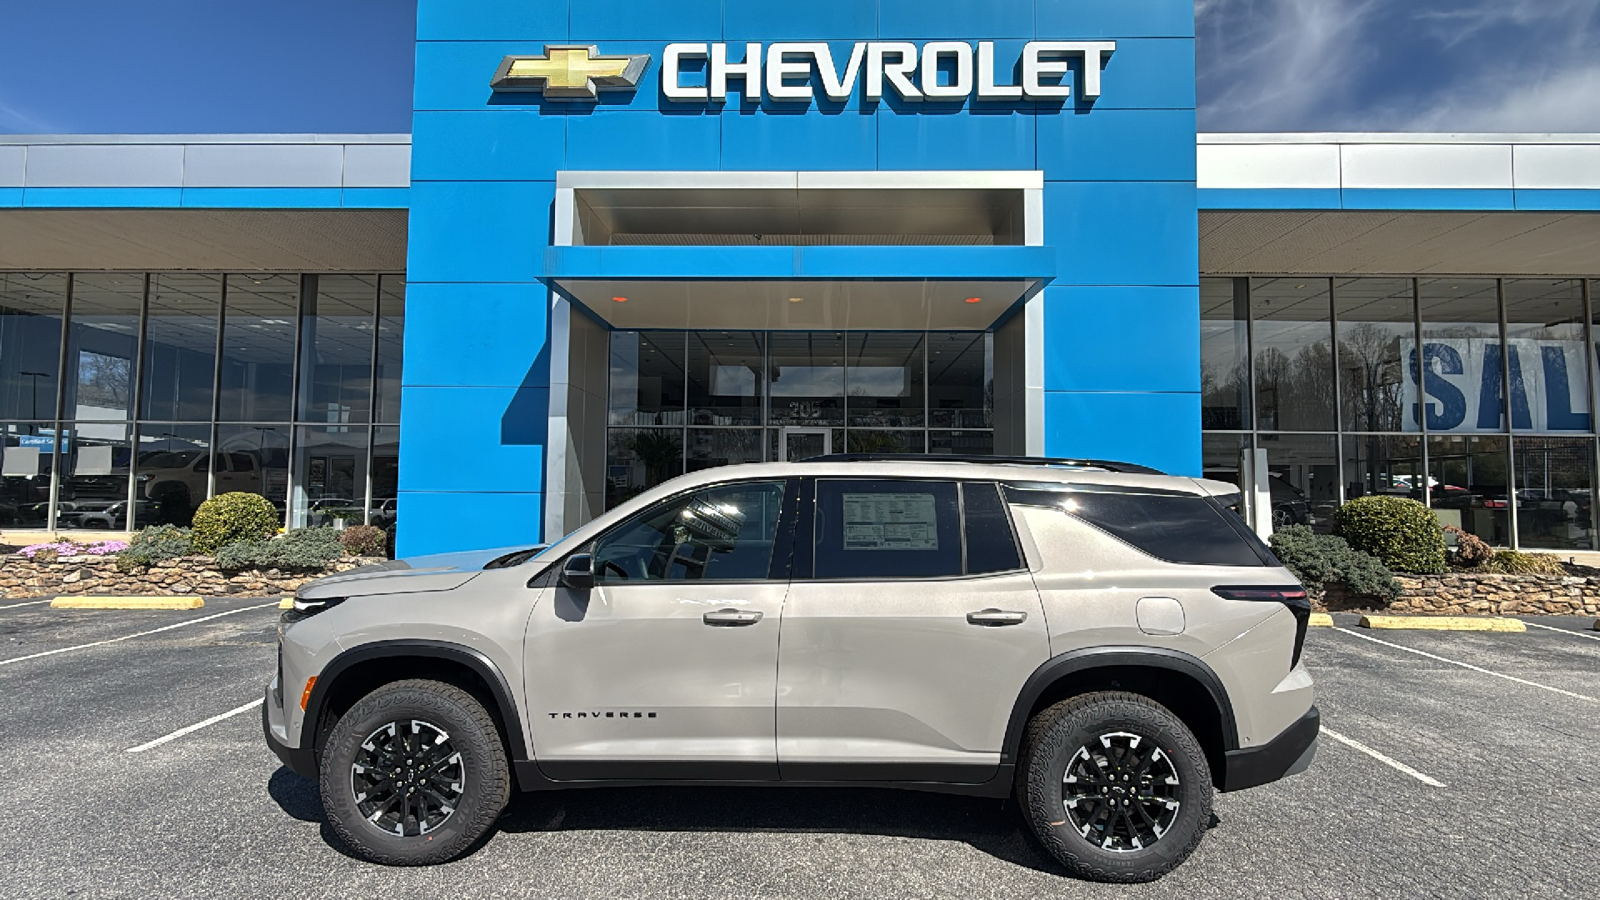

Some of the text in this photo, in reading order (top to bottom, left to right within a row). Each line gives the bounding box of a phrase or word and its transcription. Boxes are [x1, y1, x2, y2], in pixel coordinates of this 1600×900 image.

[662, 41, 1116, 102] CHEVROLET
[1409, 342, 1600, 431] SAL
[789, 401, 821, 418] 205
[548, 711, 657, 719] TRAVERSE
